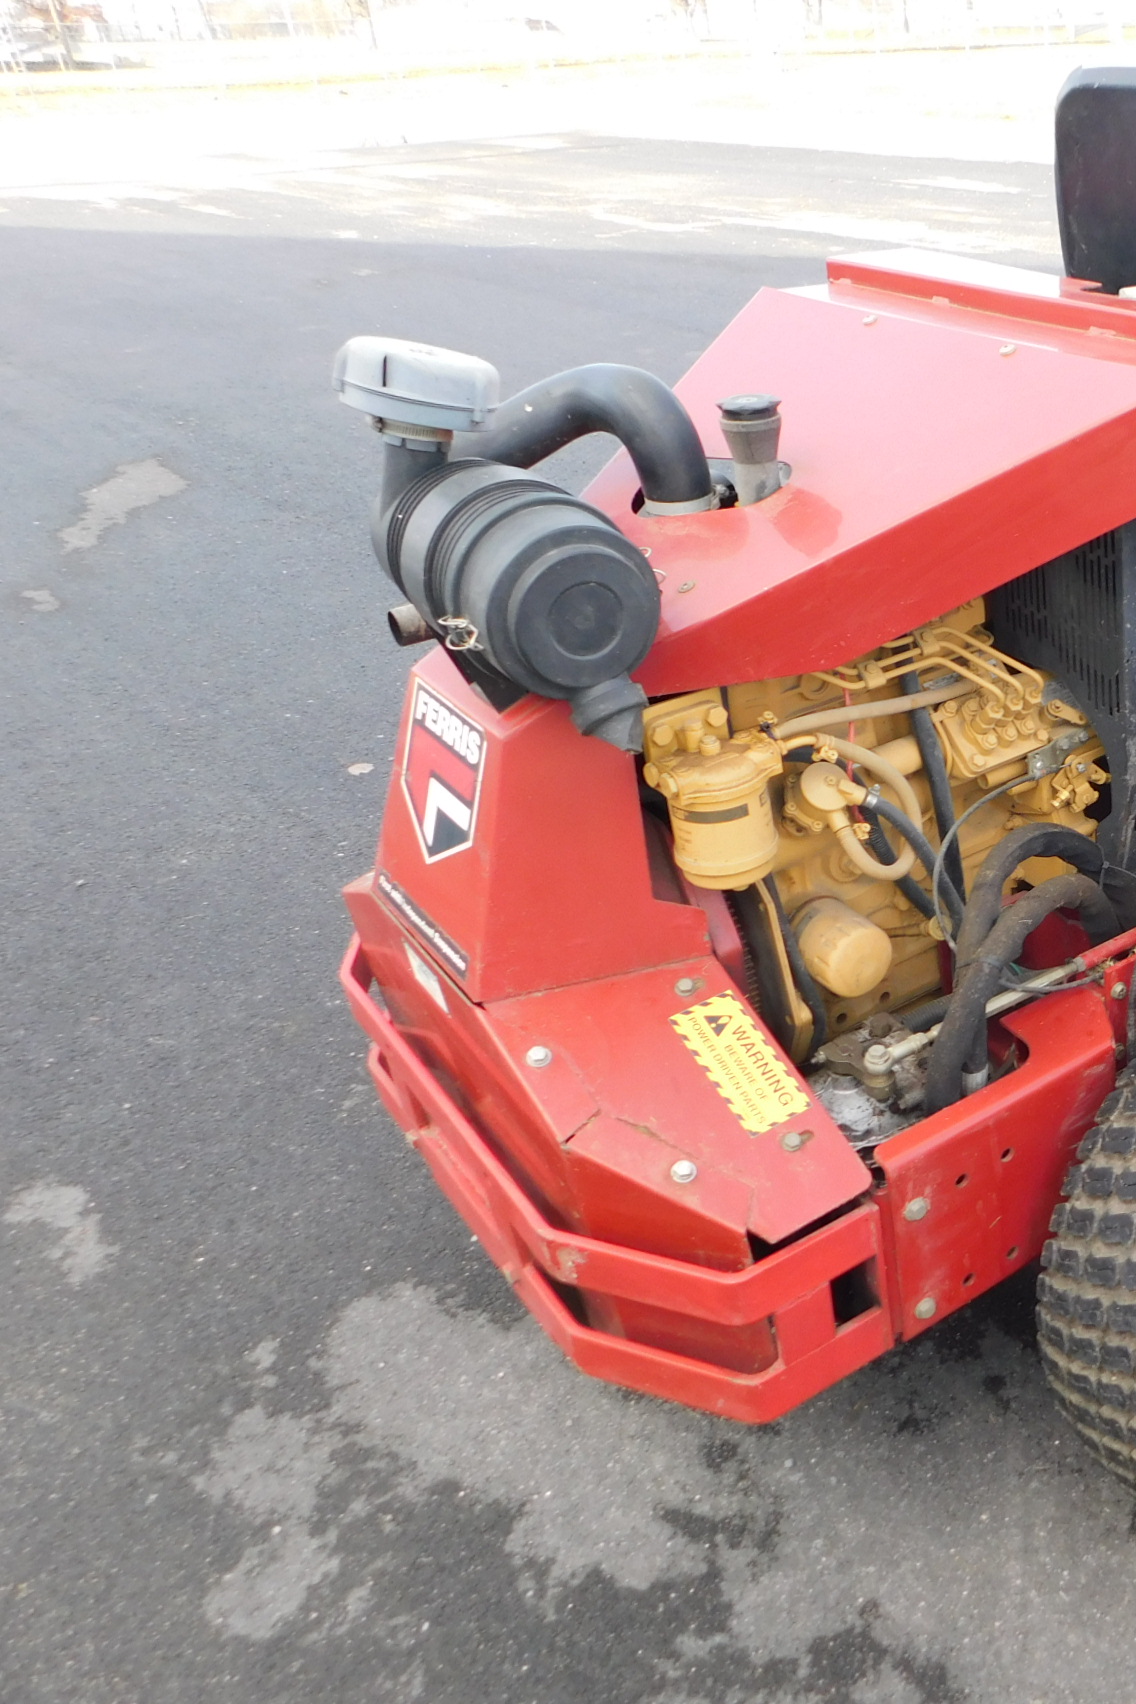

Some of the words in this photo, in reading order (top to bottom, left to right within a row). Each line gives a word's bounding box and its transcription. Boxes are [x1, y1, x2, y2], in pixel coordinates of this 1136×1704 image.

[415, 696, 481, 765] FERRIS
[688, 1017, 717, 1053] POWER
[713, 1053, 743, 1090] DRIVEN
[739, 1090, 767, 1124] PARTS
[724, 1044, 757, 1085] BEWARE
[755, 1087, 768, 1101] OF
[732, 1025, 793, 1106] WARNING
